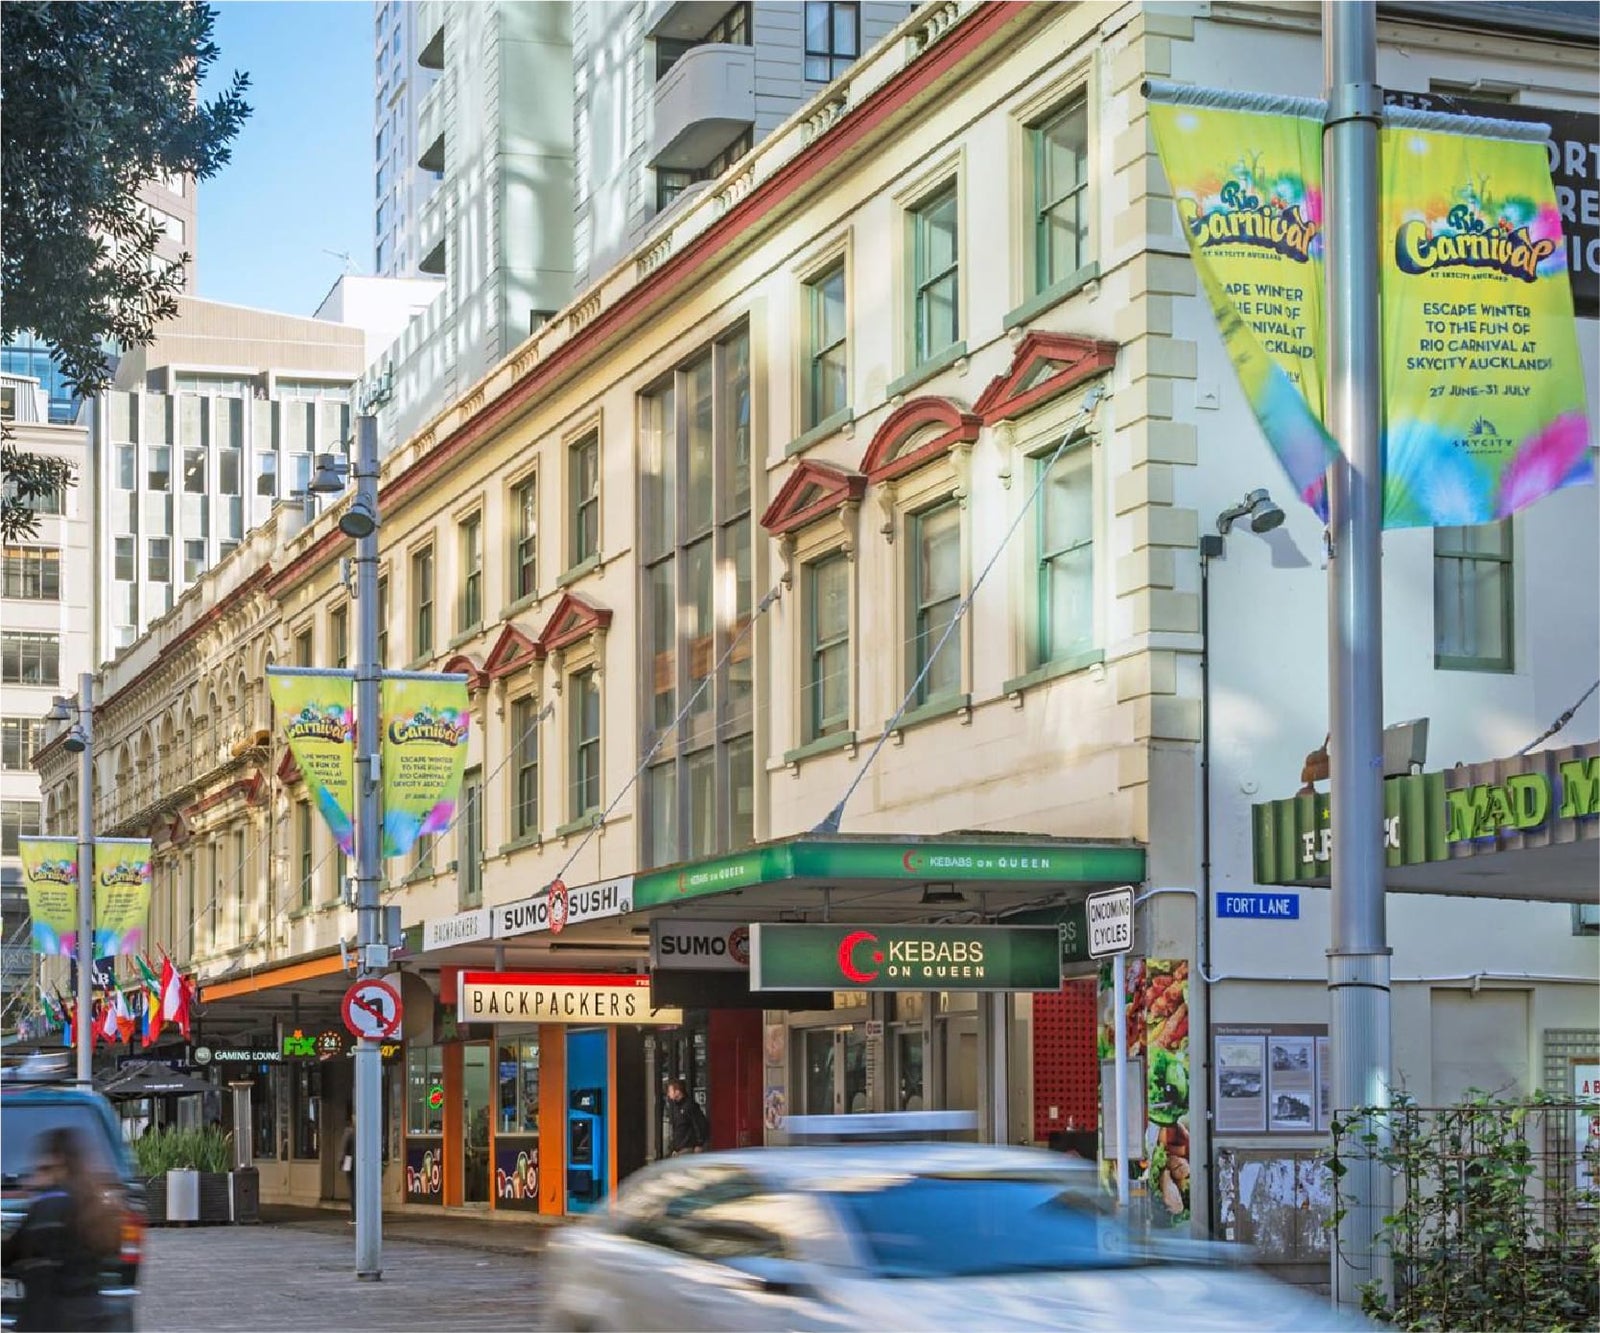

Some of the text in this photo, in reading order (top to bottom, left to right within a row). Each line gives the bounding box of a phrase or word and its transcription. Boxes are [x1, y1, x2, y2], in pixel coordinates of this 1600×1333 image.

[1221, 181, 1259, 211] Rio
[1447, 204, 1484, 234] Rio
[1400, 221, 1555, 281] Carnival
[1225, 283, 1303, 301] APE WINTER
[1256, 303, 1282, 315] FUN
[1424, 302, 1531, 318] ESCAPE WINTER
[1252, 321, 1290, 336] NIVAL
[1426, 320, 1531, 336] TO THE FUN OF
[1420, 339, 1537, 354] RIO CARNIVAL AT
[1407, 356, 1466, 371] SKYCITY
[1429, 385, 1445, 398] 27
[1502, 384, 1530, 397] JULY
[390, 720, 464, 746] Carnival
[1445, 773, 1549, 843] MAD
[930, 856, 973, 868] KEBABS
[998, 858, 1050, 869] QUEEN
[505, 886, 618, 930] SUMO SUSHI
[1091, 897, 1130, 922] ONCOMING
[1226, 897, 1291, 916] FORT LANE
[1094, 924, 1128, 946] CYCLES
[661, 936, 726, 955] SUMO
[889, 941, 984, 962] KEBABS
[889, 966, 984, 977] ON QUEEN
[473, 991, 636, 1016] BACKPACKERS
[215, 1051, 250, 1060] GAMING
